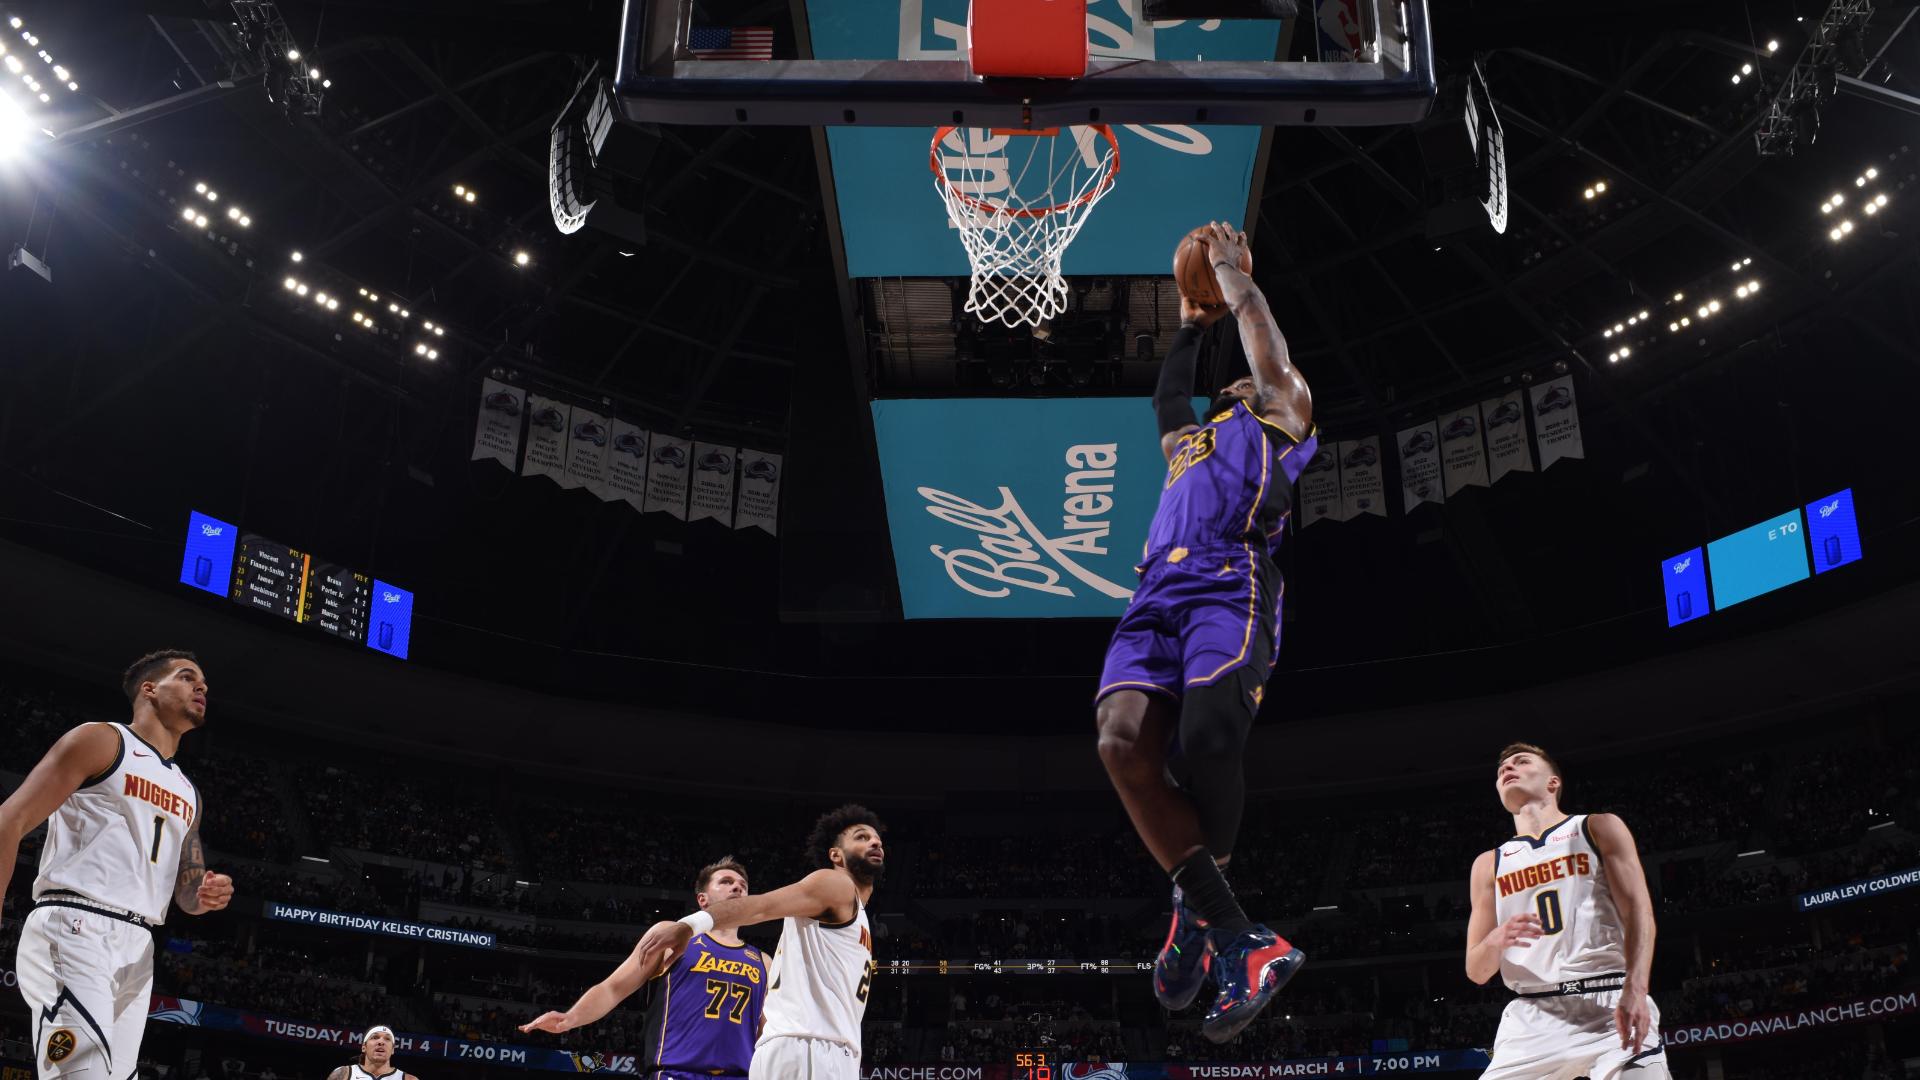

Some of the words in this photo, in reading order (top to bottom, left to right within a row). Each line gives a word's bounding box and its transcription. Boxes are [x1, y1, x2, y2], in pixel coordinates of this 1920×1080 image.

[1166, 428, 1217, 490] 23
[1051, 443, 1118, 556] Arena
[201, 523, 223, 537] Ball
[1779, 522, 1798, 537] TO
[917, 486, 1115, 598] Ball
[259, 551, 279, 563] Vincent
[250, 559, 285, 577] Finney-Smith
[257, 574, 274, 585] James
[326, 576, 342, 587] Braun
[250, 583, 279, 599] Hachimura
[321, 585, 338, 597] Porter
[253, 596, 272, 608] Doncic
[325, 598, 339, 608] Jokic
[321, 609, 340, 621] Murray
[124, 772, 195, 829] NUGGETS
[150, 813, 165, 863] 1
[1496, 852, 1591, 898] NUGGETS
[1803, 890, 1840, 907] LAURA
[1840, 883, 1868, 899] LEVY
[1536, 890, 1563, 936] 0
[274, 905, 317, 922] HAPPY
[318, 912, 381, 931] BIRTHDAY
[381, 921, 426, 938] KELSEY
[426, 927, 492, 946] CRISTIANO!
[690, 950, 760, 984] LAKERS
[1027, 963, 1044, 971] 3P%
[704, 978, 752, 1025] 77
[1659, 992, 1918, 1046] LORADOAVALANCHE.COM
[264, 1019, 344, 1046] TUESDAY,
[419, 1040, 431, 1052] 4
[459, 1044, 496, 1060] 7:00
[499, 1049, 527, 1064] PM
[1016, 1054, 1045, 1067] 56.3
[1372, 1056, 1409, 1072] 7:00
[1413, 1055, 1441, 1069] PM
[1189, 1063, 1267, 1080] TUESDAY,
[1269, 1061, 1329, 1077] MARCH
[1335, 1062, 1346, 1073] 4
